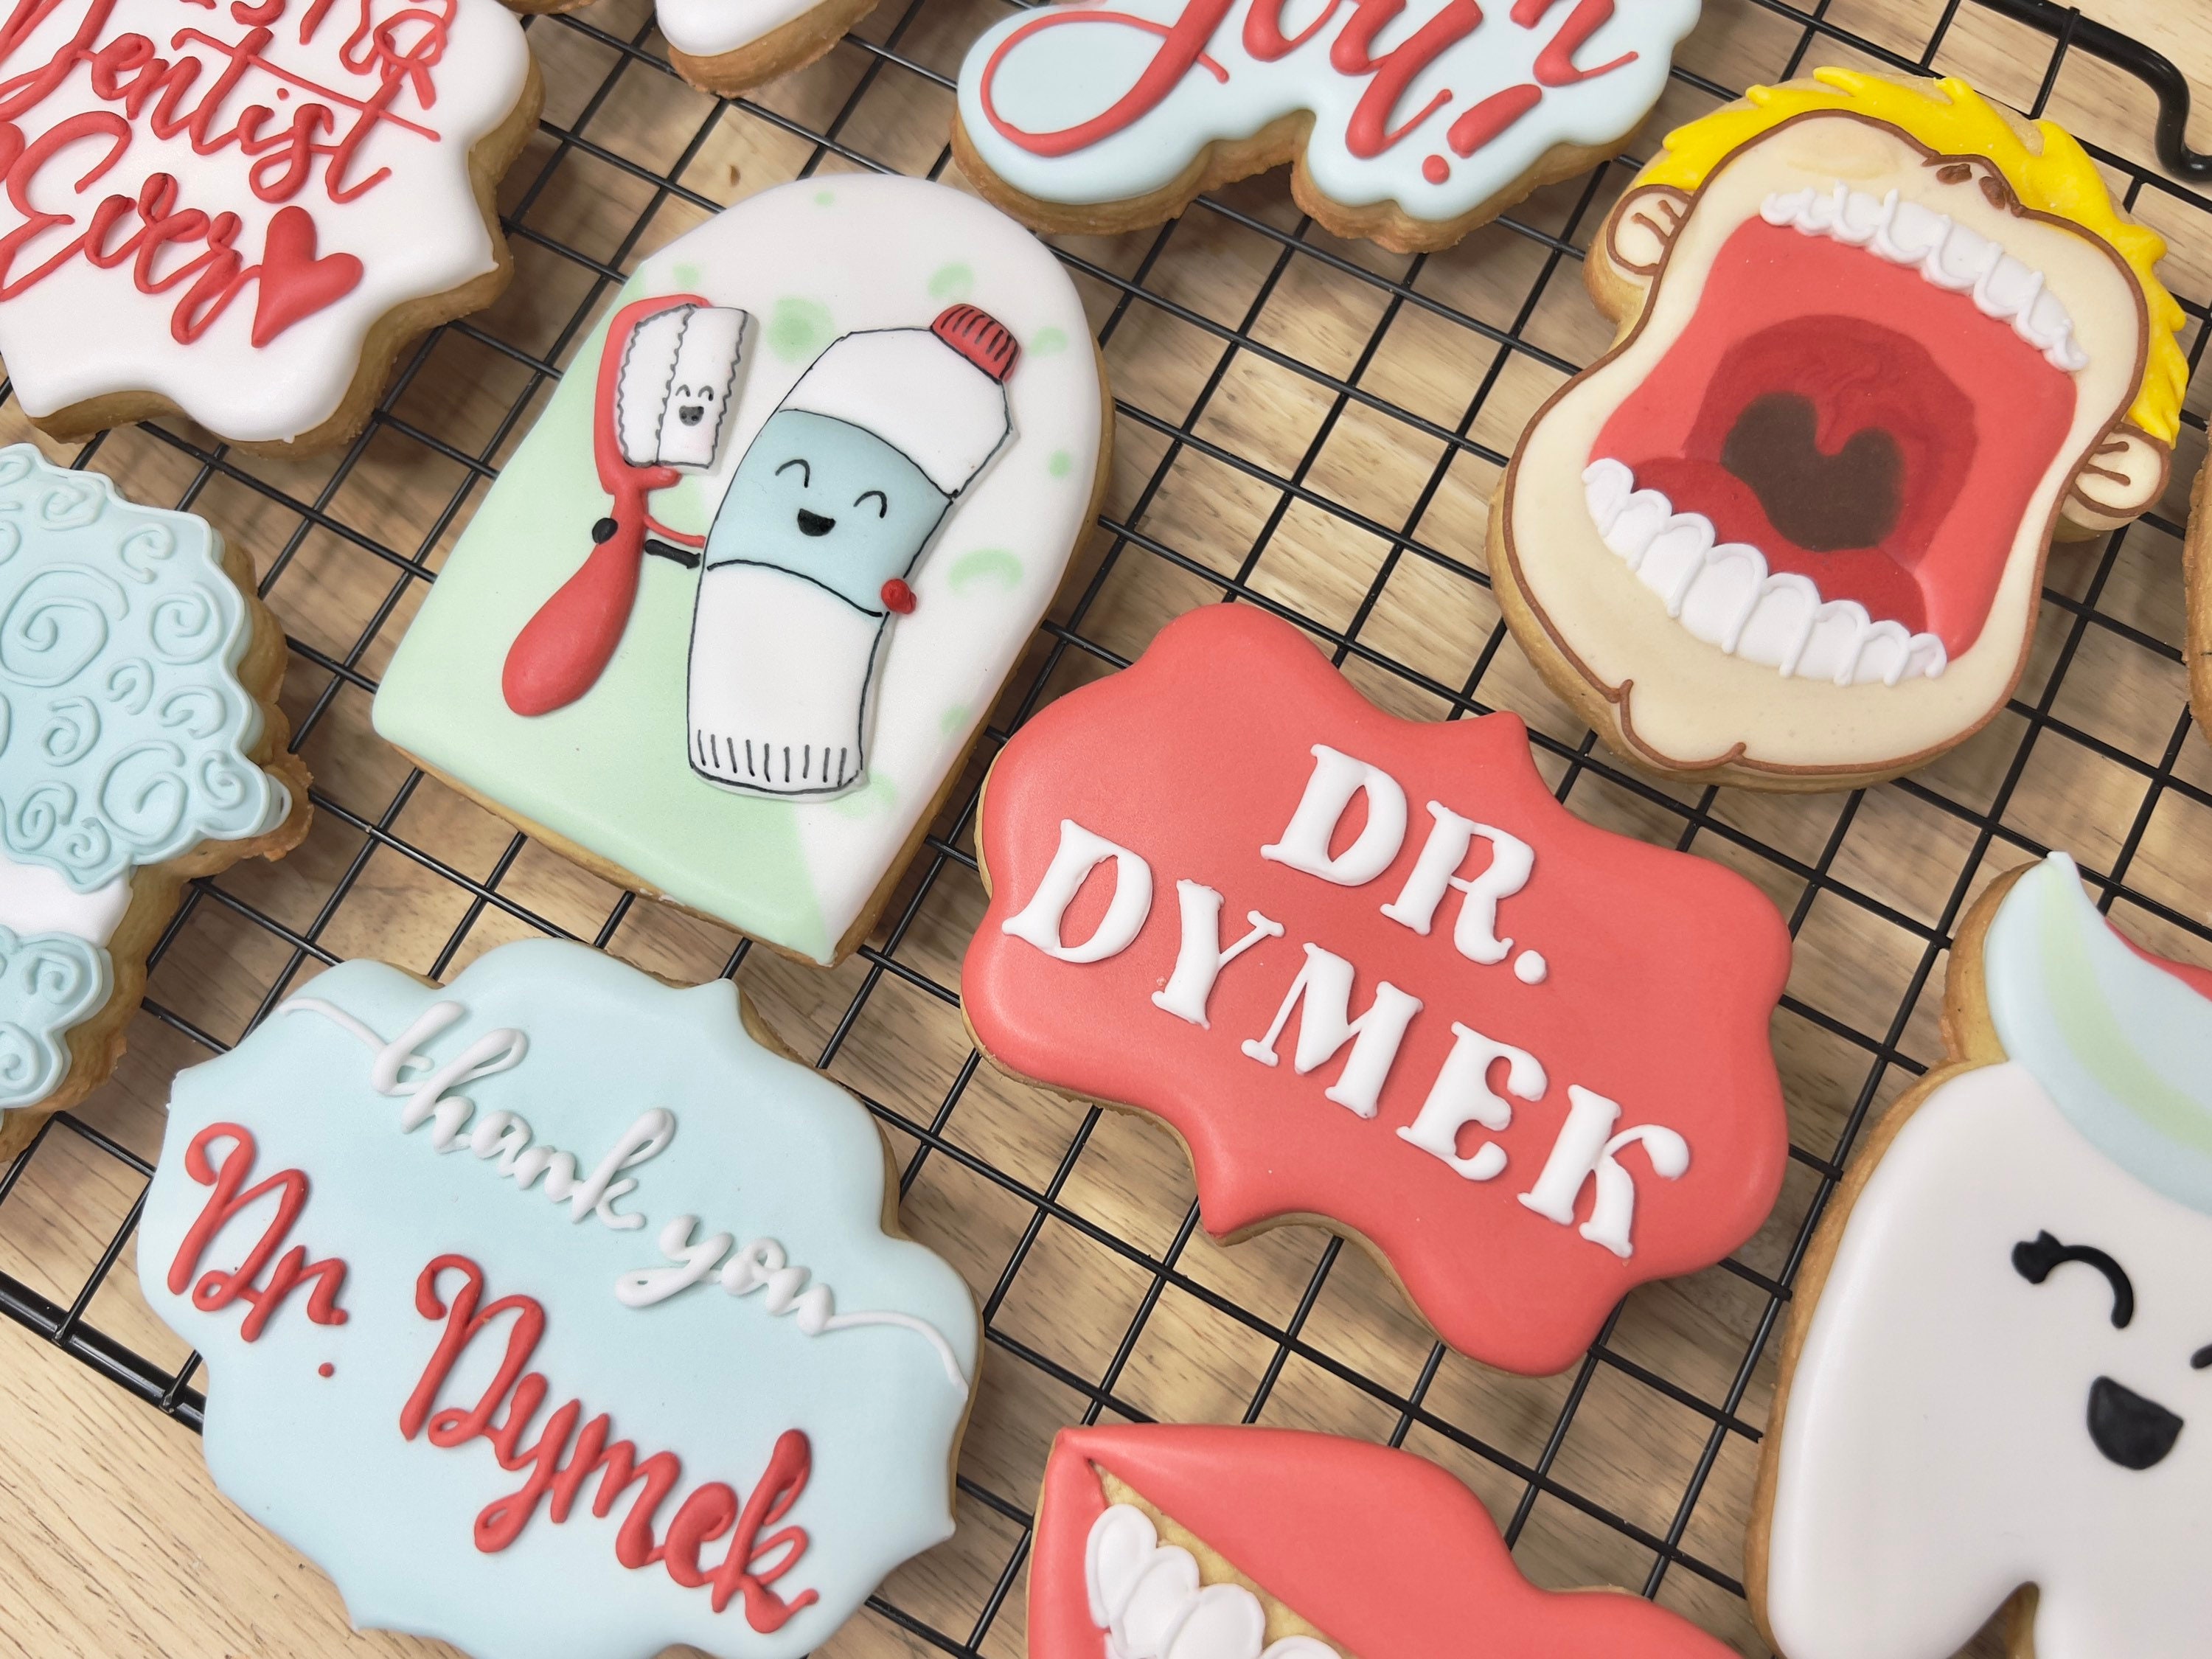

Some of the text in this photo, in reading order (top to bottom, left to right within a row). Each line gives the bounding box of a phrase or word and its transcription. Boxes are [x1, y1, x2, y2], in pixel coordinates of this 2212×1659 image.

[1260, 744, 1548, 984] DR.
[371, 1000, 678, 1229] thank
[1001, 819, 1690, 1258] DYMEK
[167, 1122, 819, 1634] Dr. Dymek
